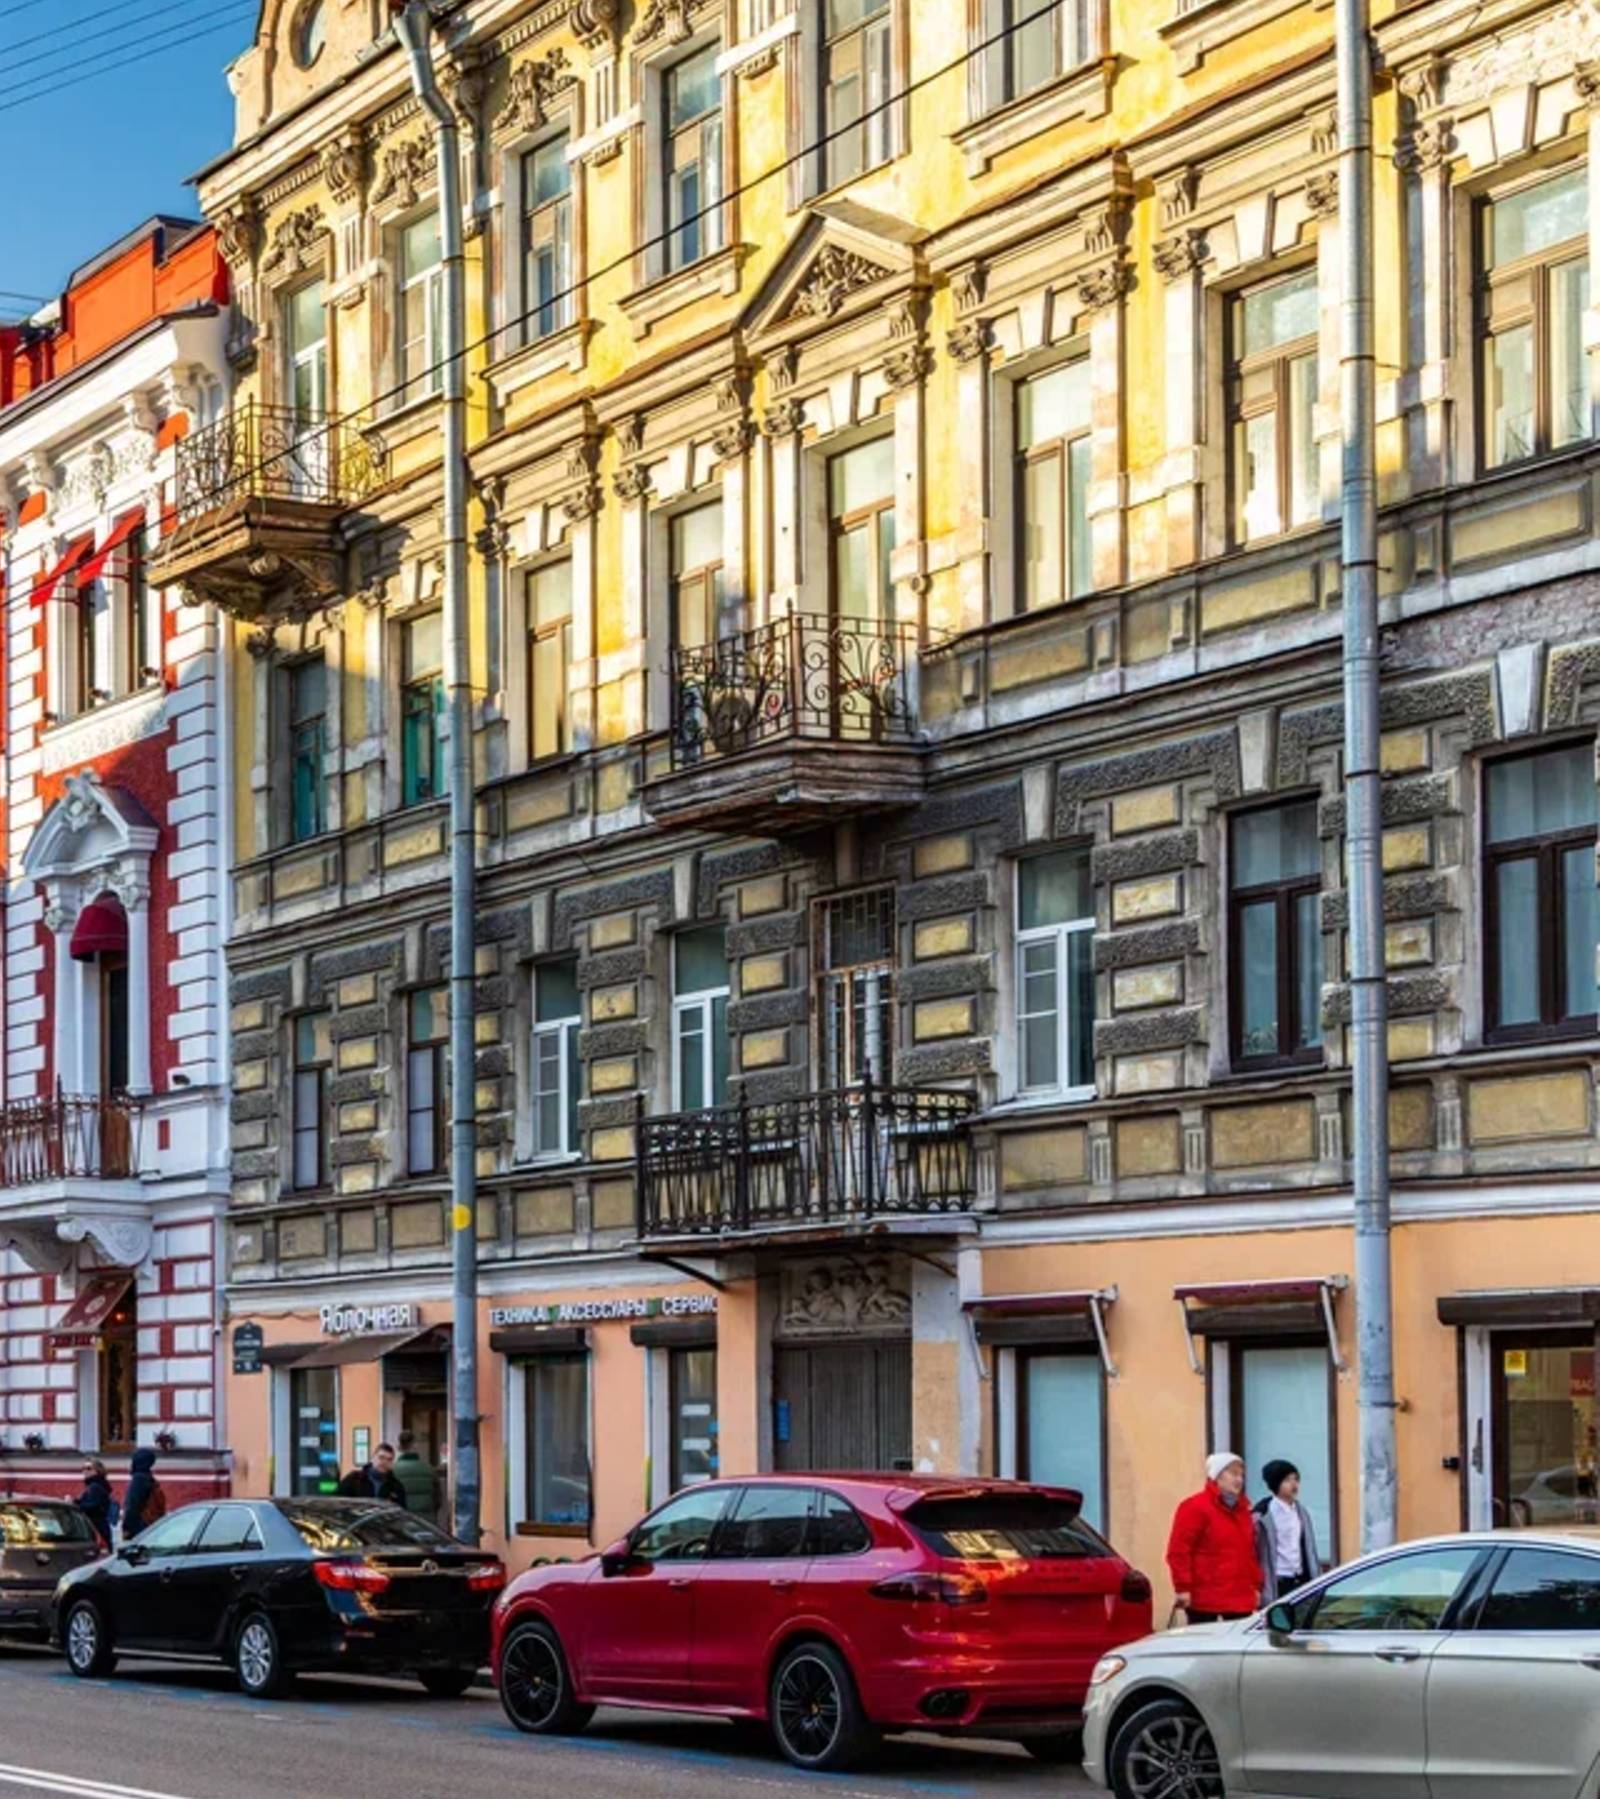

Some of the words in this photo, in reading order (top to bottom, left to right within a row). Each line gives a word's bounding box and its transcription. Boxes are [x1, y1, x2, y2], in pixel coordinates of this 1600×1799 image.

[320, 1303, 412, 1333] Яблочная
[489, 1305, 546, 1325] ТЕХНИКА
[557, 1298, 647, 1322] АКСЕССУАРЫ
